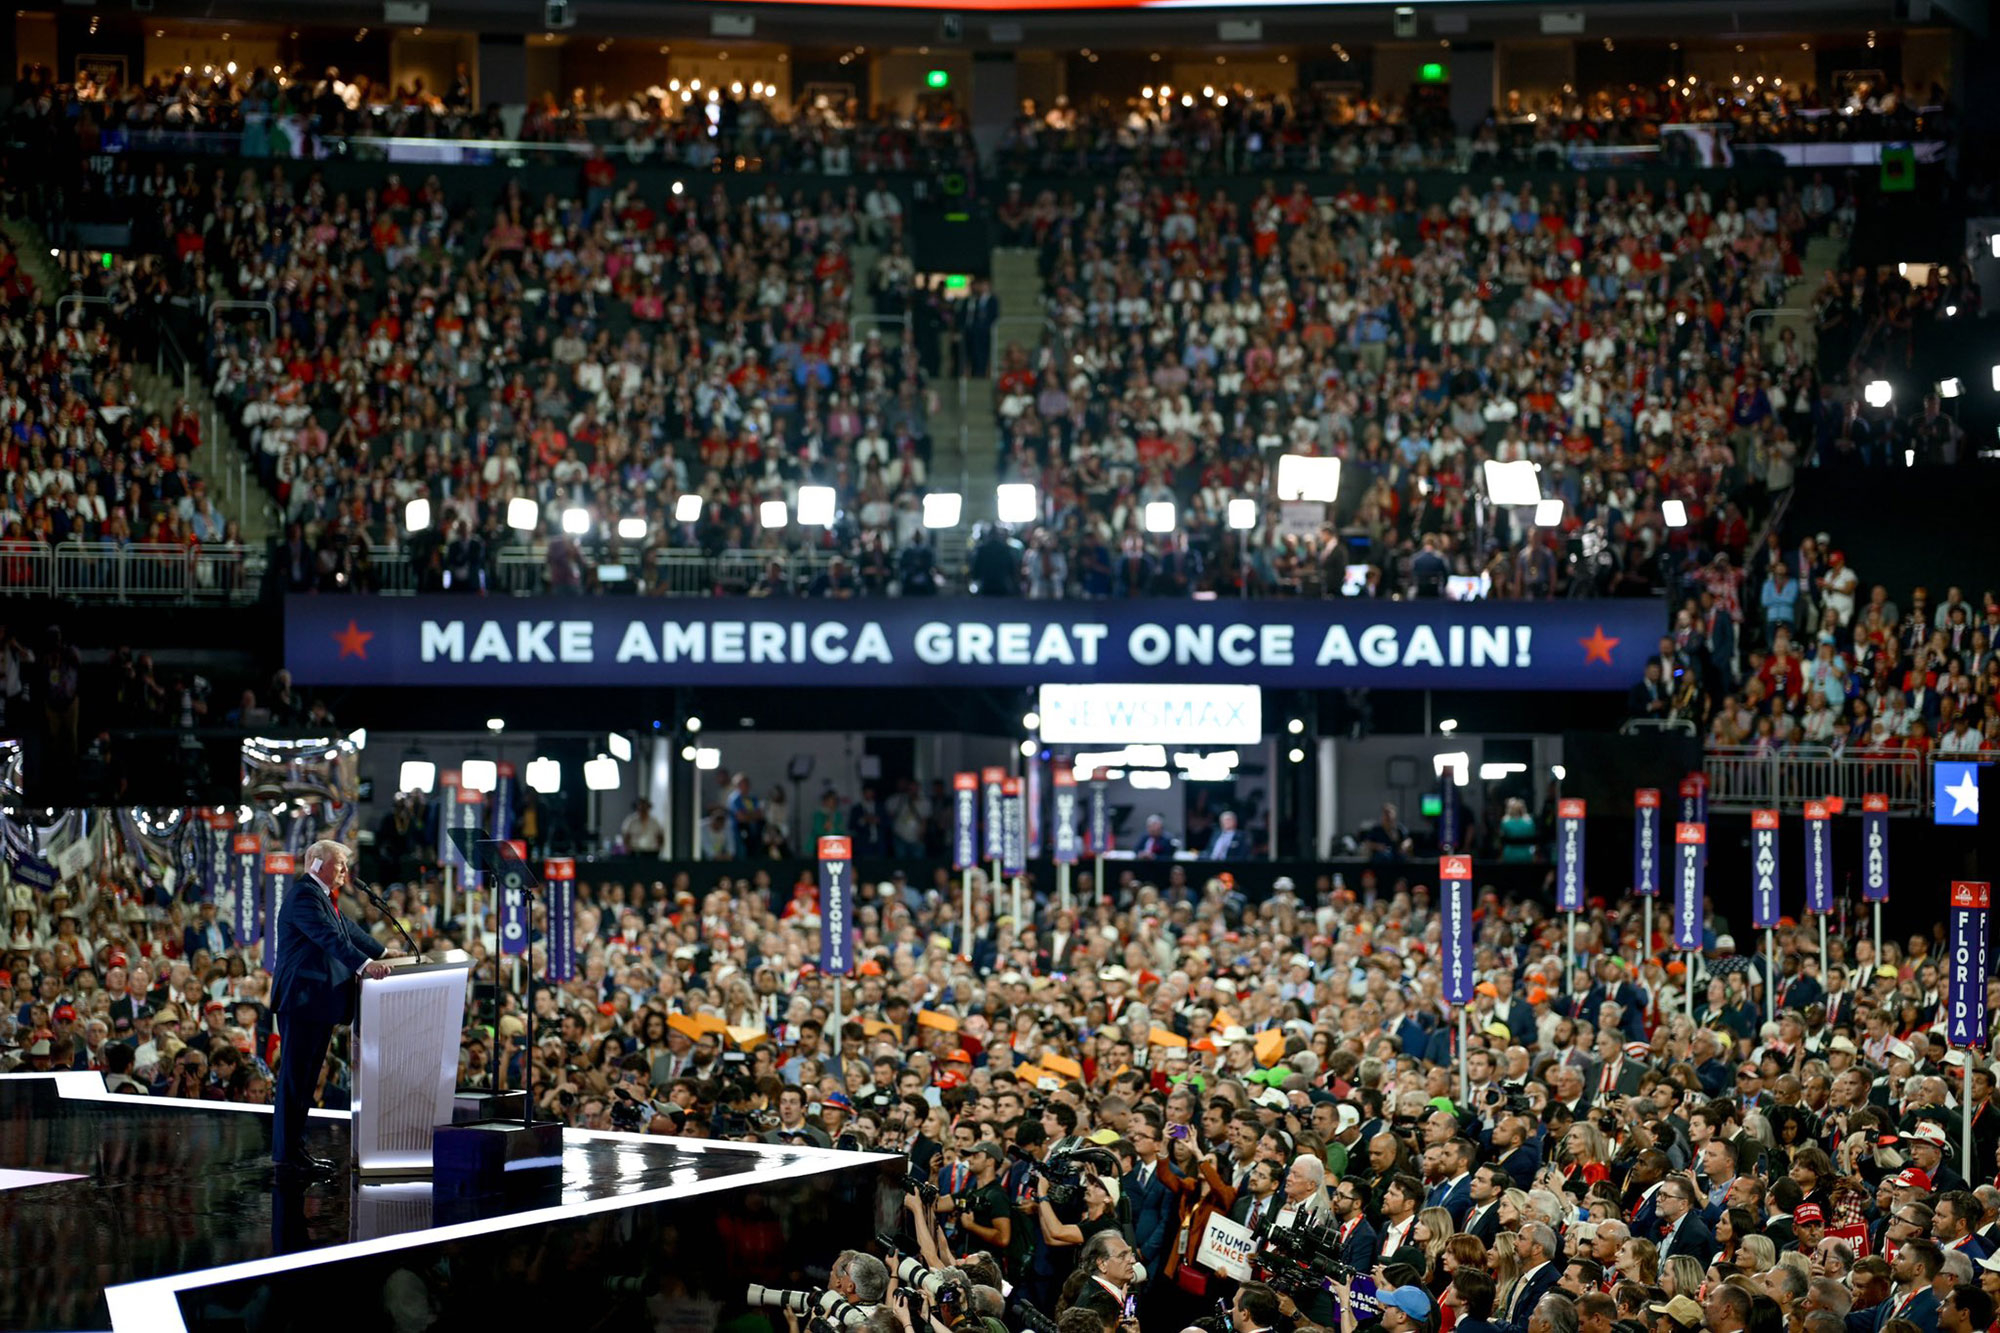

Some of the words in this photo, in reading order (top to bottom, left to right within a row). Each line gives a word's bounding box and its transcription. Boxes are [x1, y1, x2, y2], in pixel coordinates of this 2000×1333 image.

[420, 620, 594, 662] MAKE
[616, 620, 894, 663] AMERICA
[914, 622, 1108, 666] GREAT
[1127, 623, 1295, 667] ONCE
[1316, 625, 1533, 668] AGAIN!
[1053, 701, 1245, 727] NEWSMAX
[1057, 794, 1074, 850] UTAH
[1564, 819, 1578, 905] MICHIGAN
[1641, 807, 1653, 890] VIRGINIA
[1812, 820, 1823, 908] MISSISSIPPI
[1868, 820, 1883, 888] IDAHO
[241, 853, 254, 941] MISSOURI
[504, 871, 522, 940] OHIO
[826, 862, 844, 968] WISCONSIN
[1682, 845, 1696, 944] MINNESOTA
[1756, 830, 1775, 920] HAWAII
[1451, 881, 1463, 998] PENNSYLVANIA
[1954, 912, 1969, 1037] FLORIDA
[1976, 912, 1986, 1038] FLORIDA
[1210, 1240, 1244, 1263] VANCE
[1211, 1226, 1251, 1254] TRUMP
